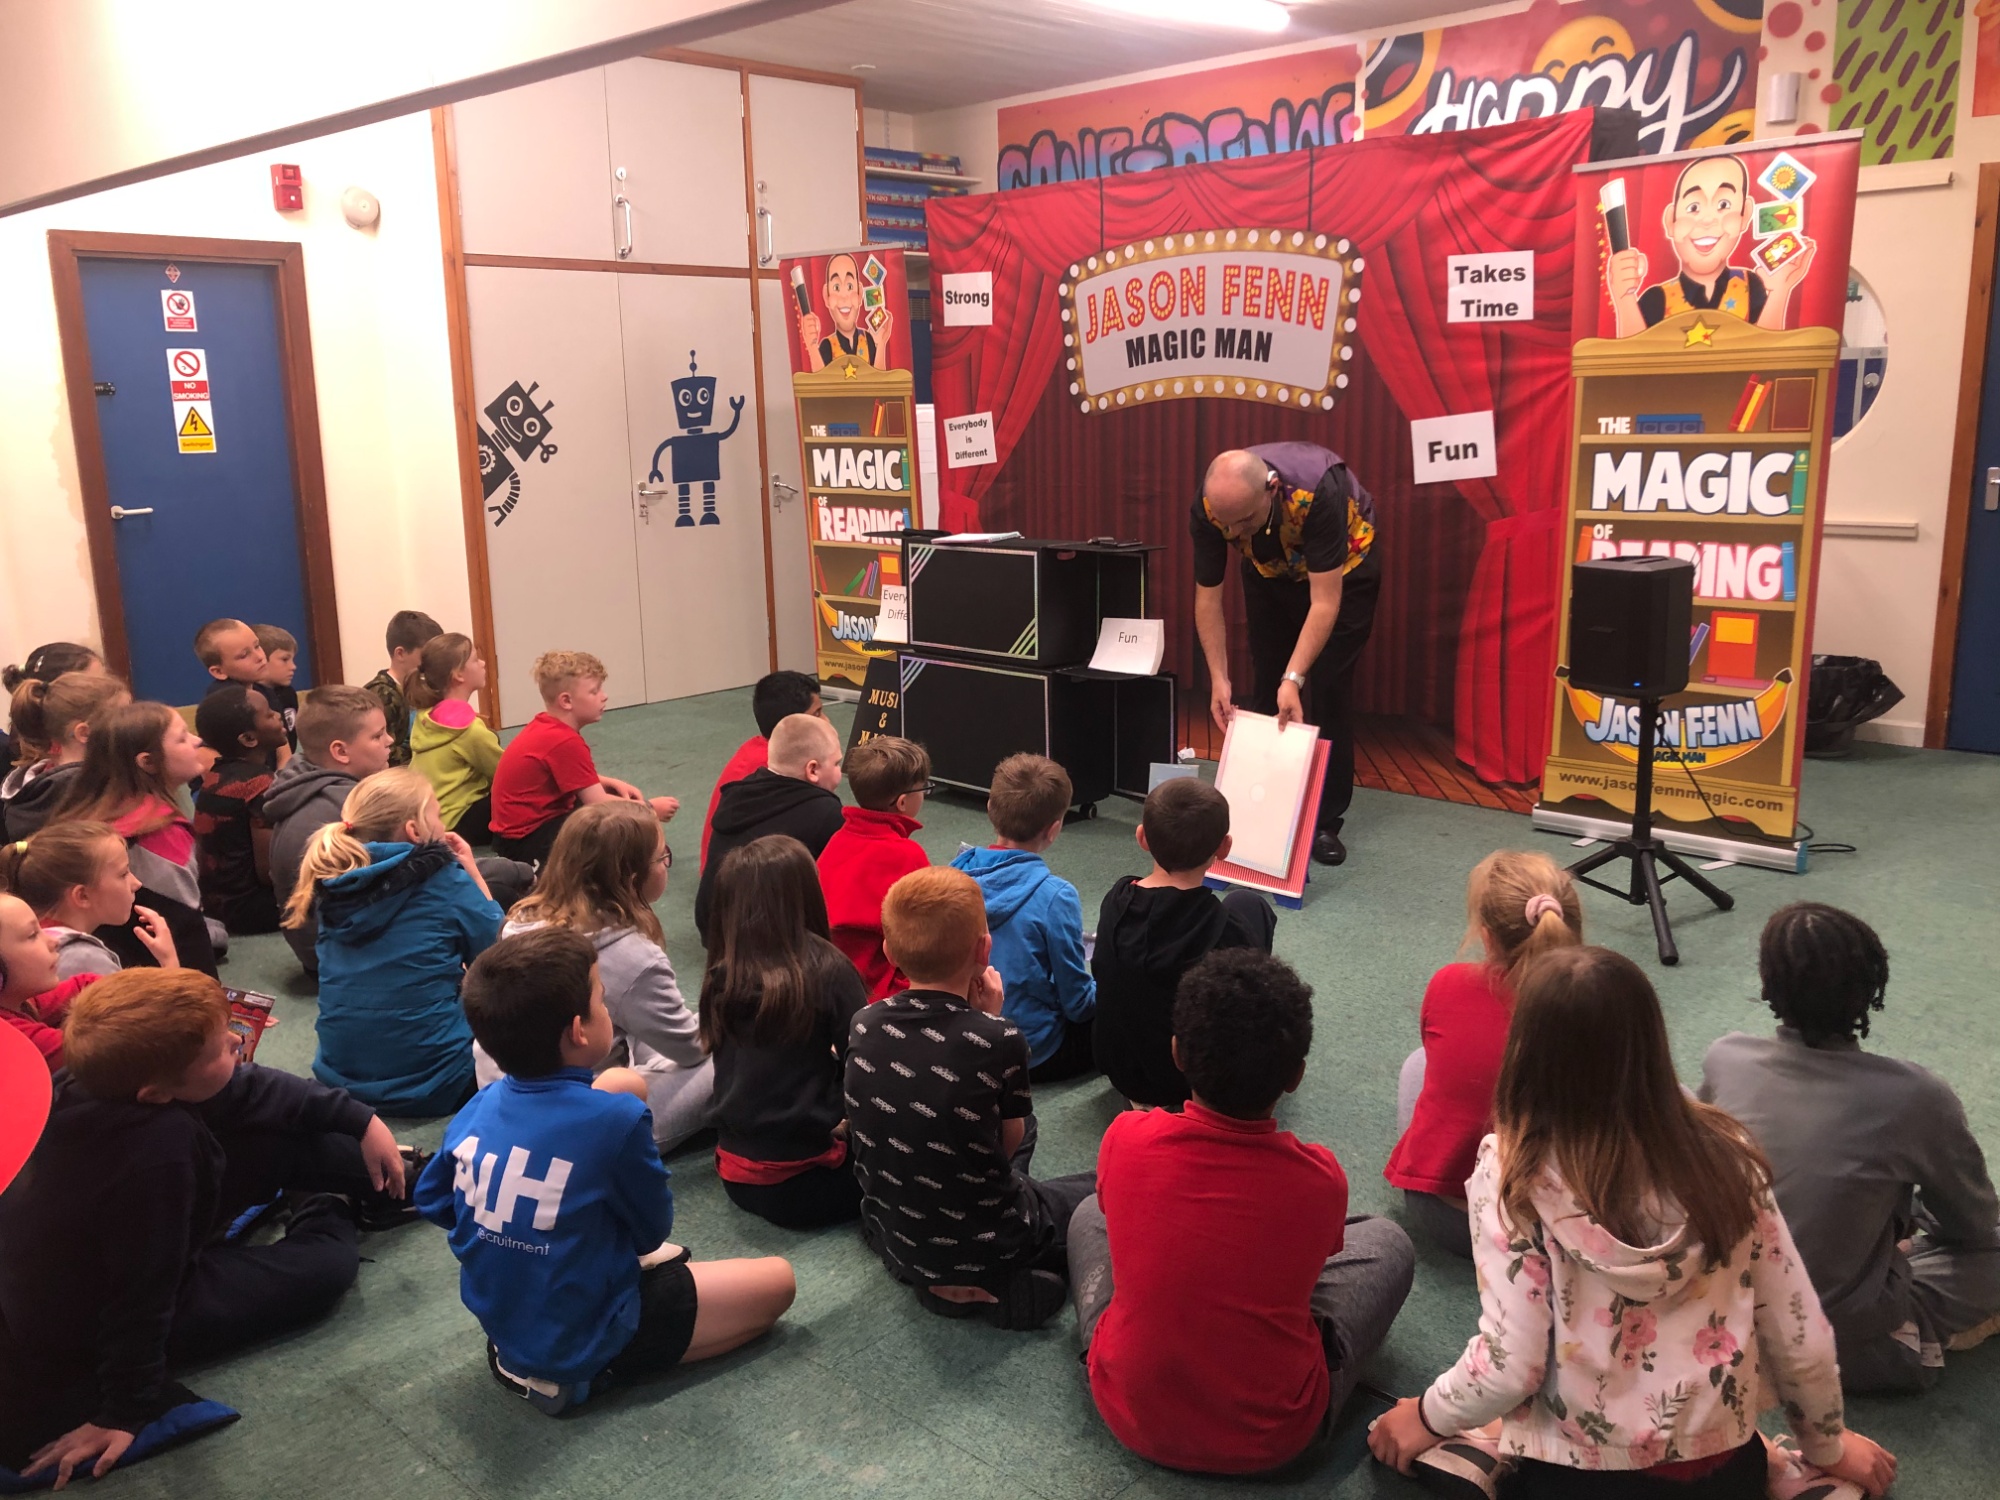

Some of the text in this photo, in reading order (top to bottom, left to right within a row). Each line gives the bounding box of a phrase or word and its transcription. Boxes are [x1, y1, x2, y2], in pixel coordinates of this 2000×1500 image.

[1411, 33, 1744, 154] Happy
[1454, 264, 1527, 284] Takes
[945, 290, 990, 307] Strong
[1086, 264, 1330, 344] JASON FENN
[1460, 299, 1519, 318] Time
[1125, 327, 1273, 368] MAGIC MAN
[173, 392, 209, 400] SMOKING
[810, 425, 827, 437] THE
[948, 417, 988, 432] Everybody
[1597, 416, 1631, 435] THE
[965, 436, 973, 444] is
[955, 448, 988, 461] Different
[1427, 440, 1479, 463] Fun
[811, 447, 903, 491] MAGIC
[1590, 449, 1795, 516] MAGIC
[817, 496, 828, 507] OF
[818, 507, 905, 546] READING
[1593, 523, 1614, 540] OF
[1118, 631, 1138, 645] Fun
[878, 711, 888, 728] &
[1584, 697, 1680, 748] JASN
[1684, 699, 1763, 748] FENN
[1682, 751, 1706, 763] MAN
[1559, 771, 1784, 812] www.jasofennmagic.com
[477, 1227, 550, 1256] recruitment
